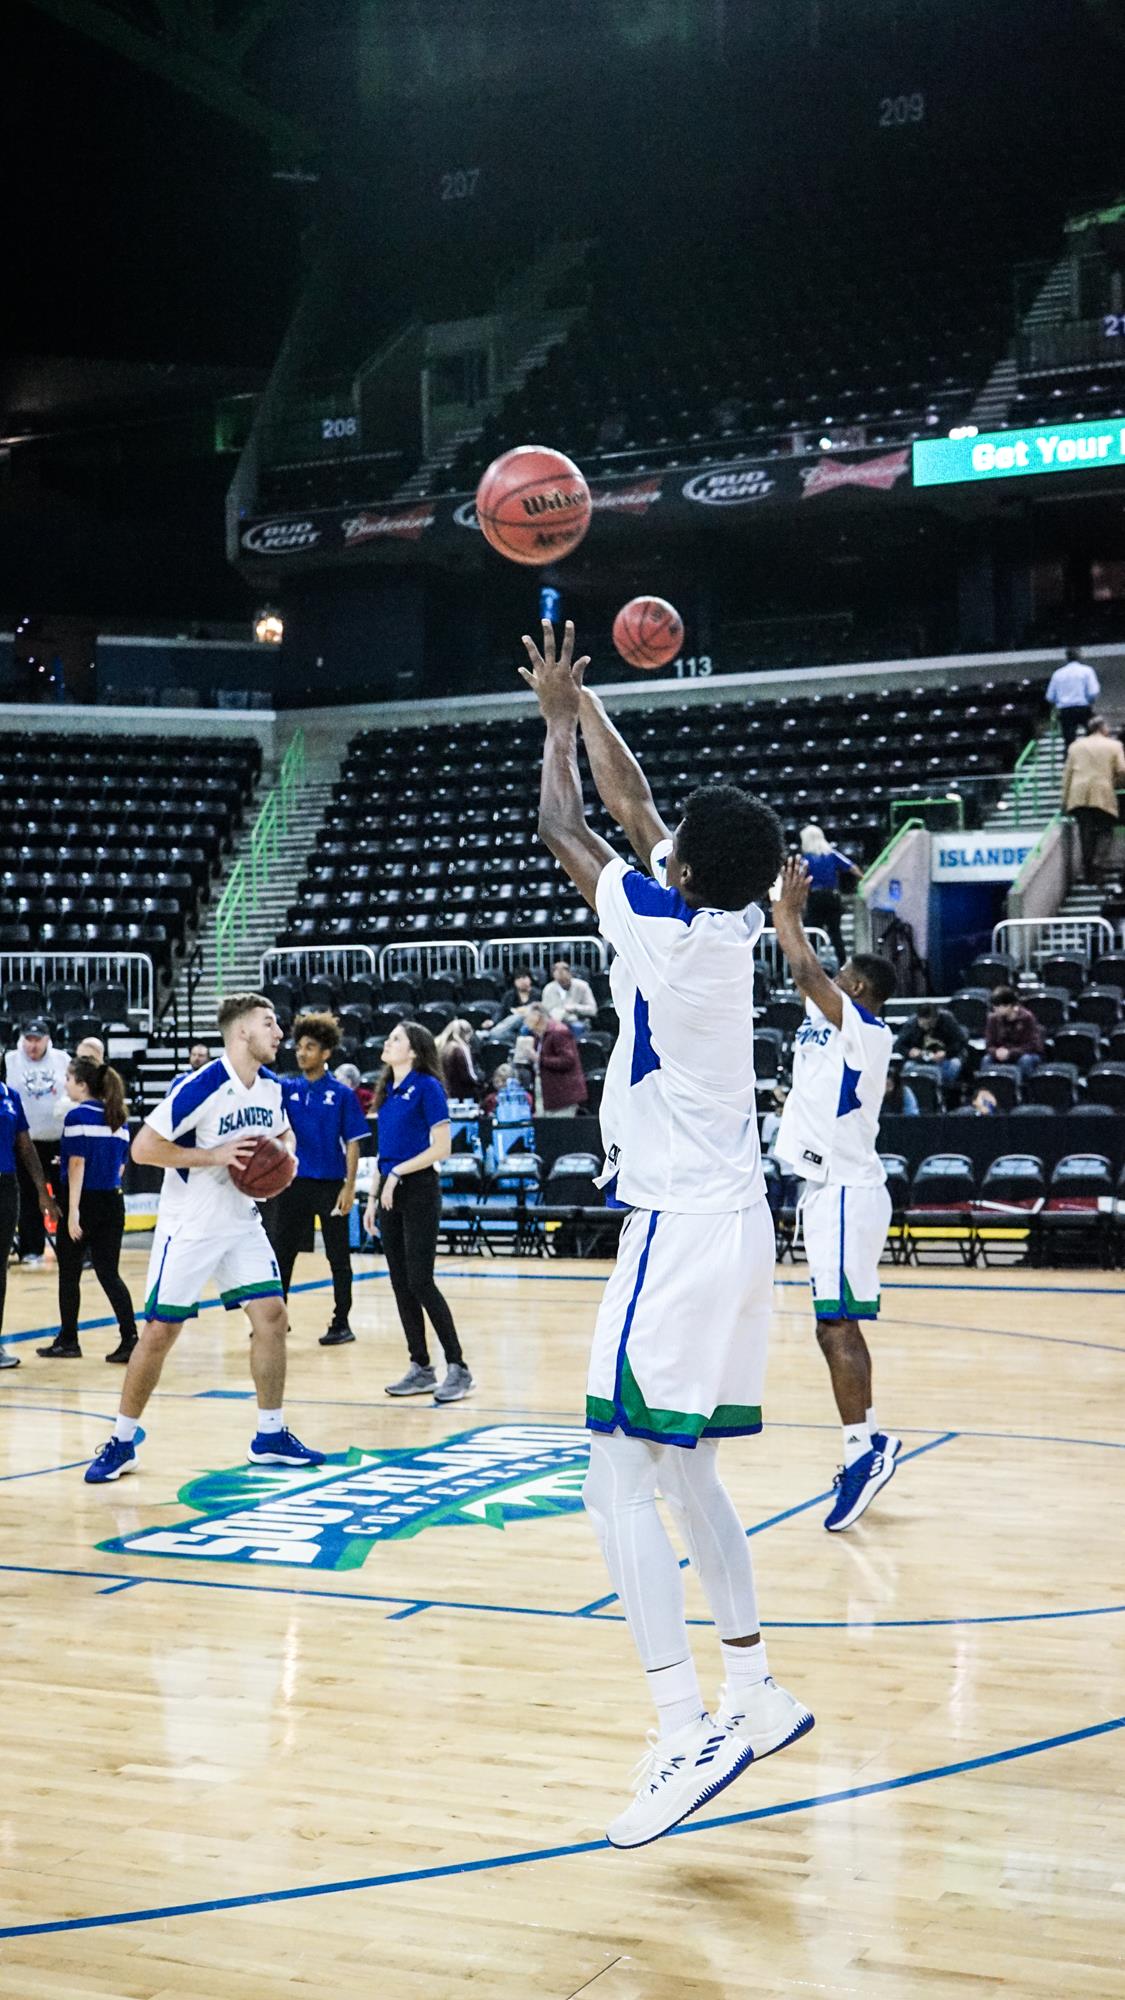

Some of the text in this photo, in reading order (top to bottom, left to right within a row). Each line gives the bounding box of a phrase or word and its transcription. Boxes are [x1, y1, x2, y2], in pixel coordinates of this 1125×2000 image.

[879, 93, 924, 126] 209
[972, 440, 1029, 472] Get
[1036, 435, 1113, 464] Your
[707, 471, 768, 488] BUD
[262, 521, 314, 537] BUD
[673, 656, 713, 678] 113
